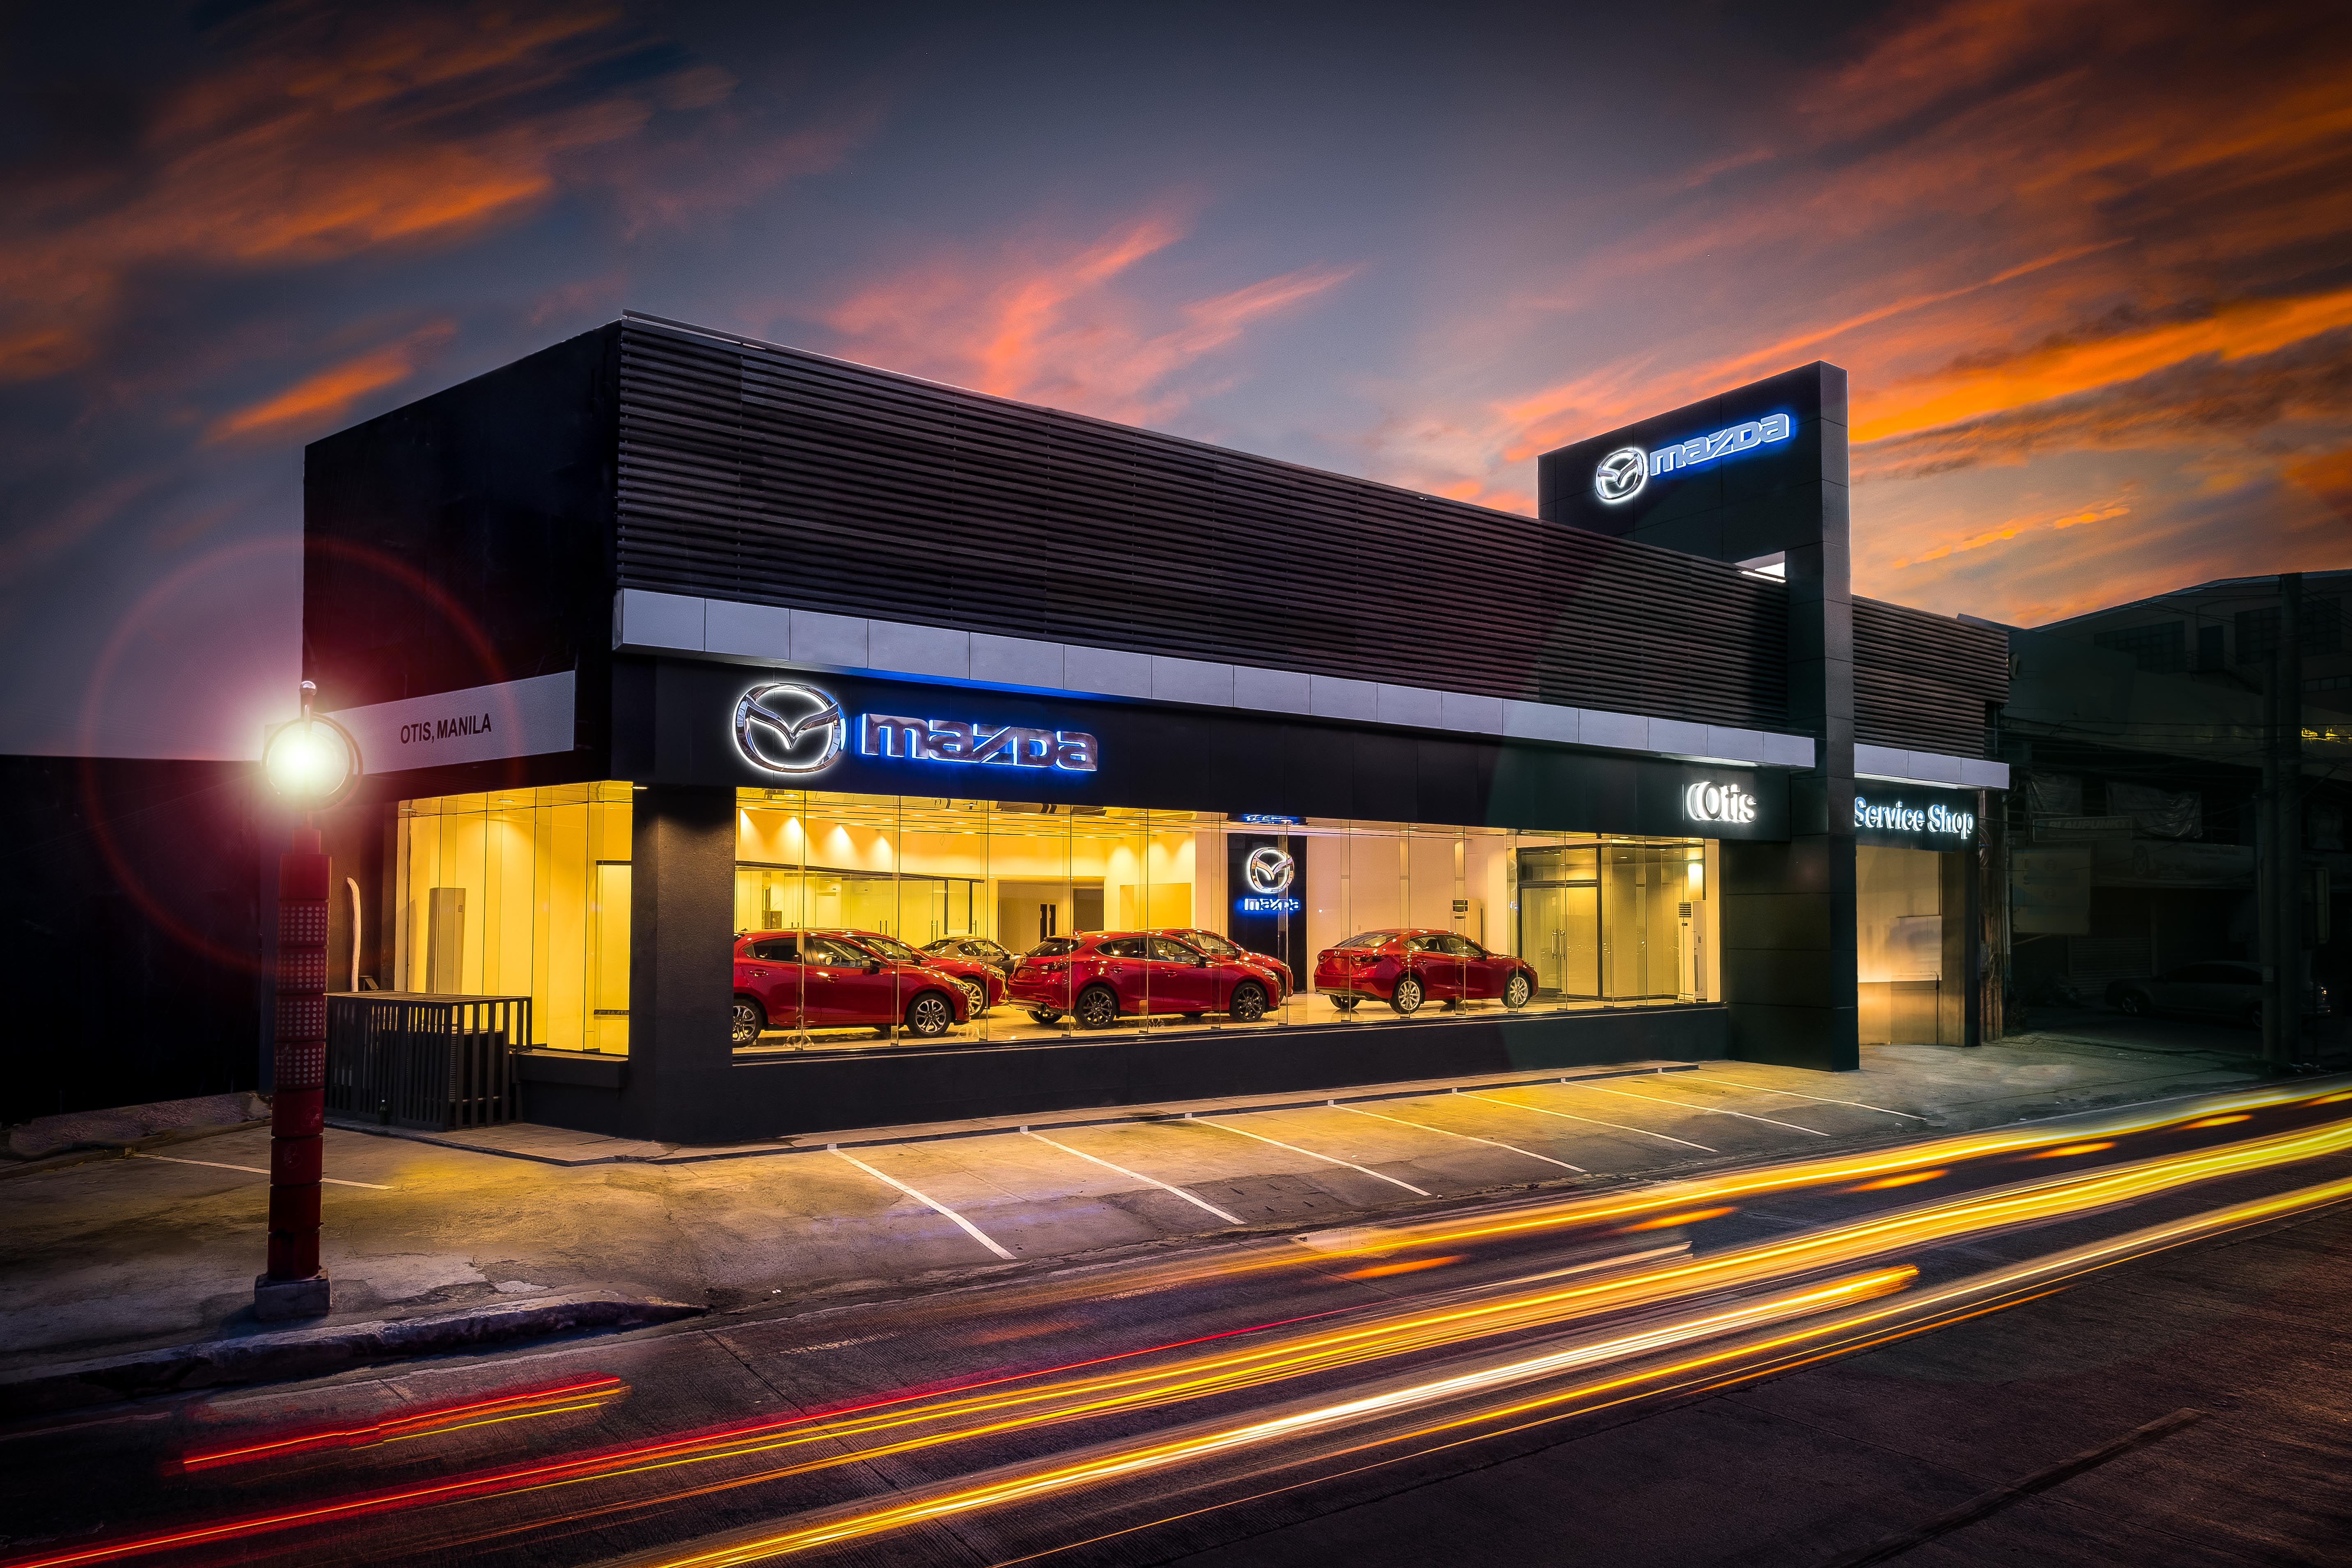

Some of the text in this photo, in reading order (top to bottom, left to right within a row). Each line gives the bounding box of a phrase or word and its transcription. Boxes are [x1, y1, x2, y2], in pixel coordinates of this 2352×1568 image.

[1695, 782, 1757, 823] Otis
[1855, 797, 1974, 839] Service Shop
